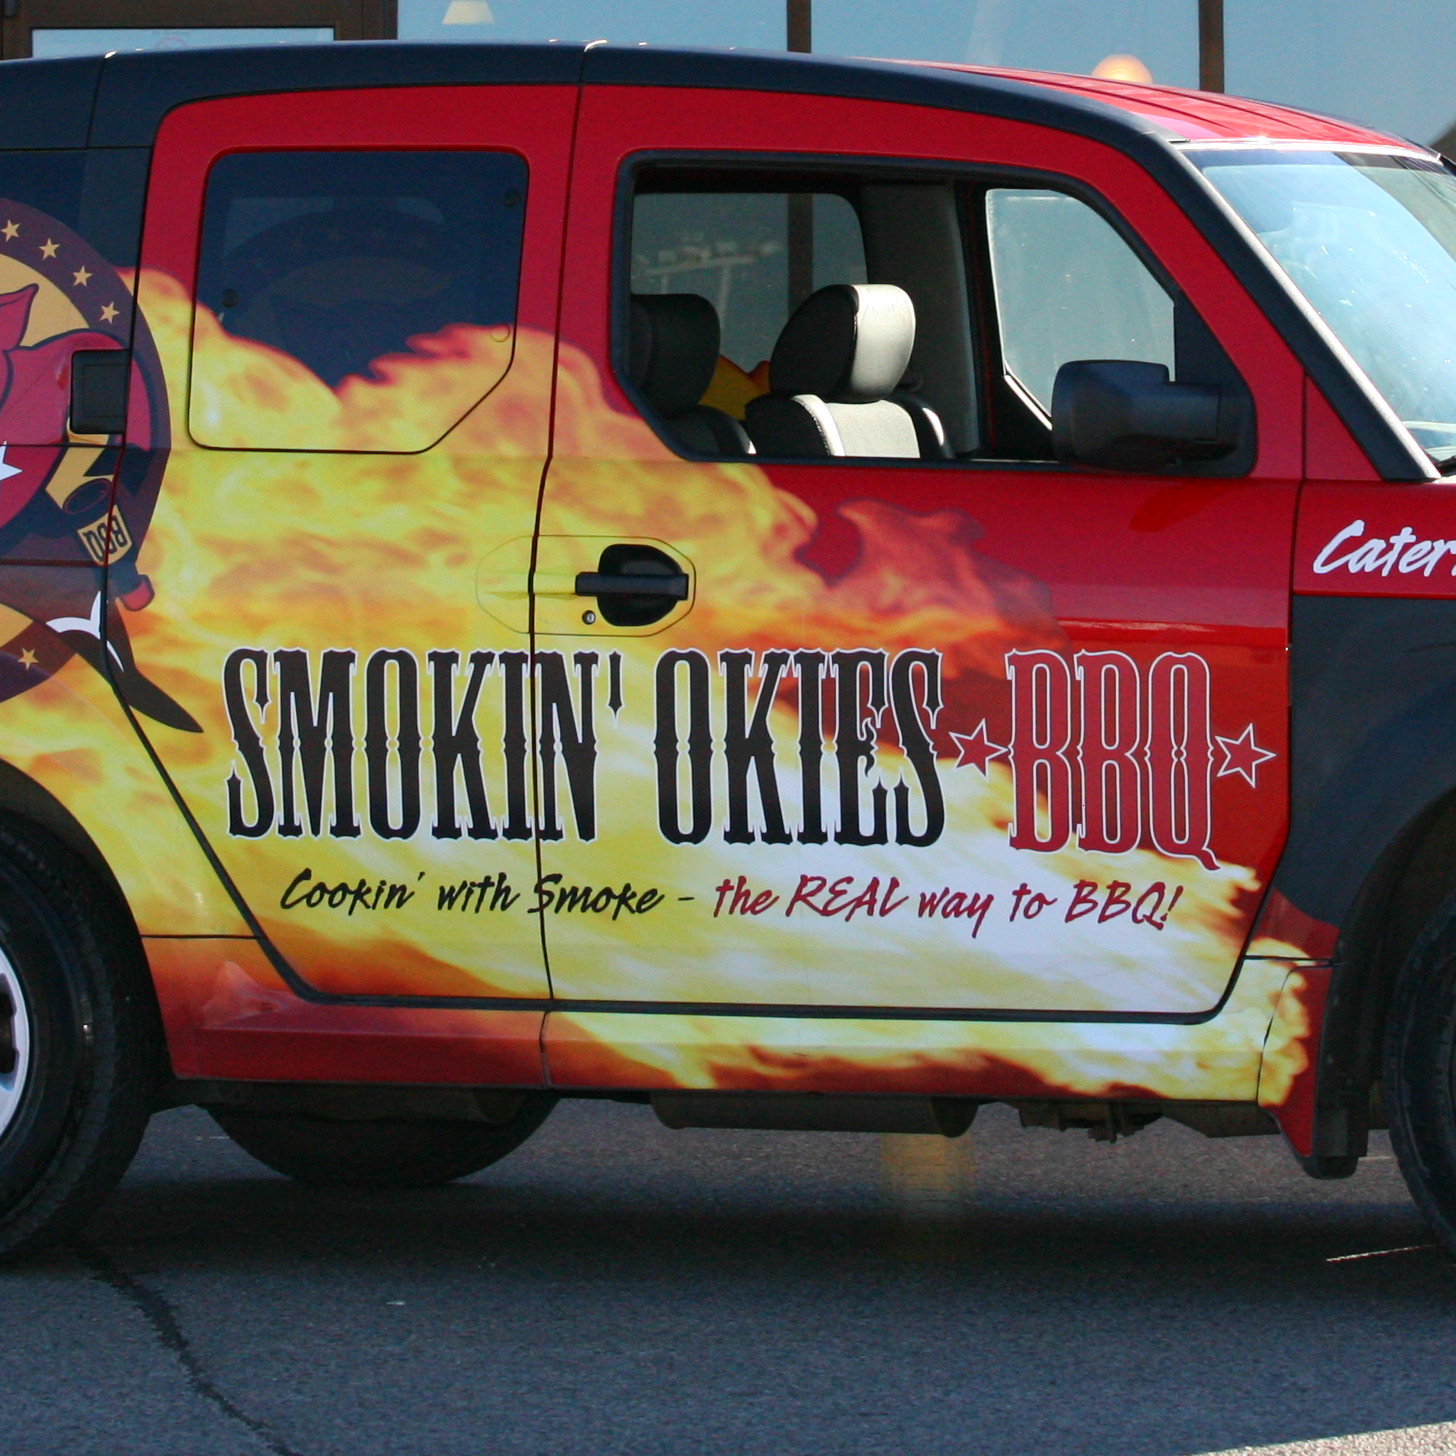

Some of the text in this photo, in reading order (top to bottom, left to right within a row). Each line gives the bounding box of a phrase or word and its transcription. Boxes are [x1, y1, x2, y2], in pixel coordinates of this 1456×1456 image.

[222, 646, 1221, 871] SMOKIN' OKIES BBQ
[280, 868, 425, 916] Cookin'
[437, 872, 521, 914] with
[528, 873, 665, 921] Smoke
[714, 875, 781, 918] the
[786, 874, 910, 923] REAL
[918, 889, 994, 939] way
[1010, 881, 1058, 922] to
[1065, 880, 1184, 932] BBQ!
